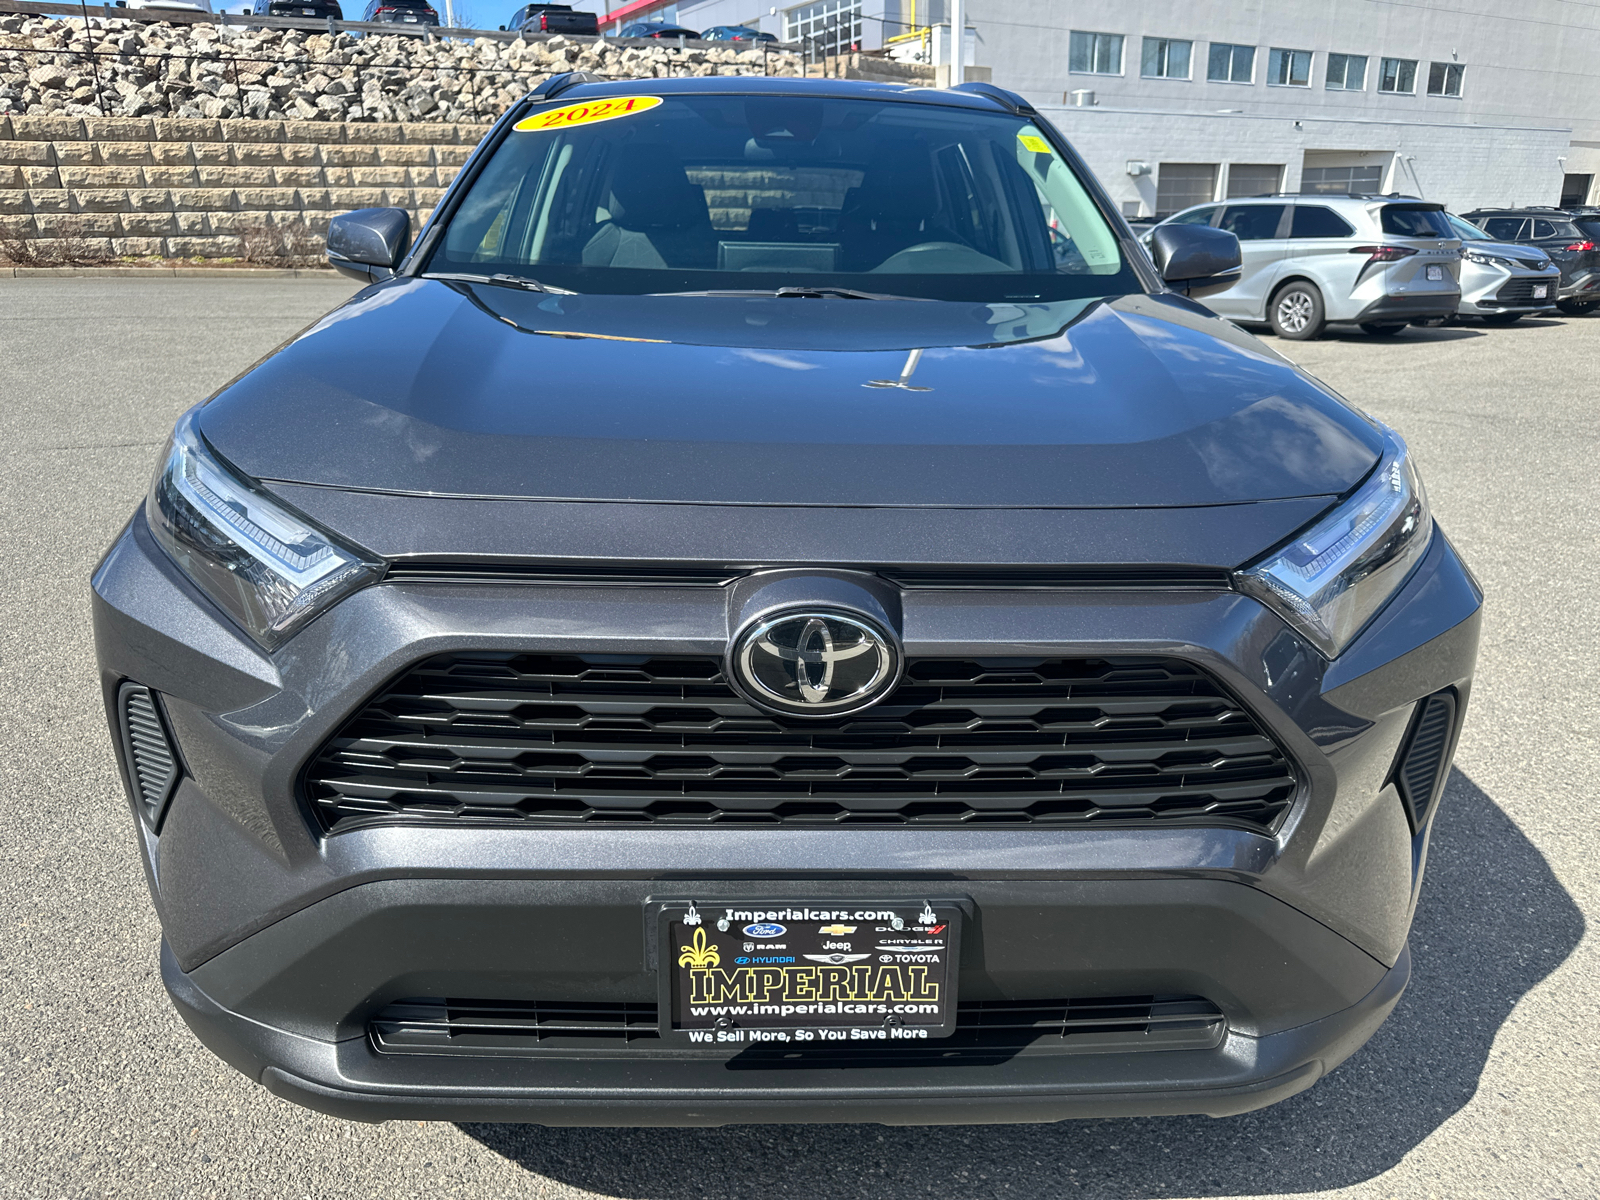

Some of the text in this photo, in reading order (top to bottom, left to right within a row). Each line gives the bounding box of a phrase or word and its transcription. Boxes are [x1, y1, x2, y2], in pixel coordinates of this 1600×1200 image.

[541, 99, 637, 127] 2024
[725, 908, 895, 923] Imperialcars.com
[752, 926, 777, 935] Ford
[822, 941, 852, 951] Jeep
[752, 956, 796, 964] HYUNDAI
[895, 954, 940, 963] TOYOTA
[690, 966, 939, 1004] IMPERIAL
[690, 1001, 939, 1017] www.imperialcars.com
[688, 1028, 928, 1043] We Sell More, So You Save More
